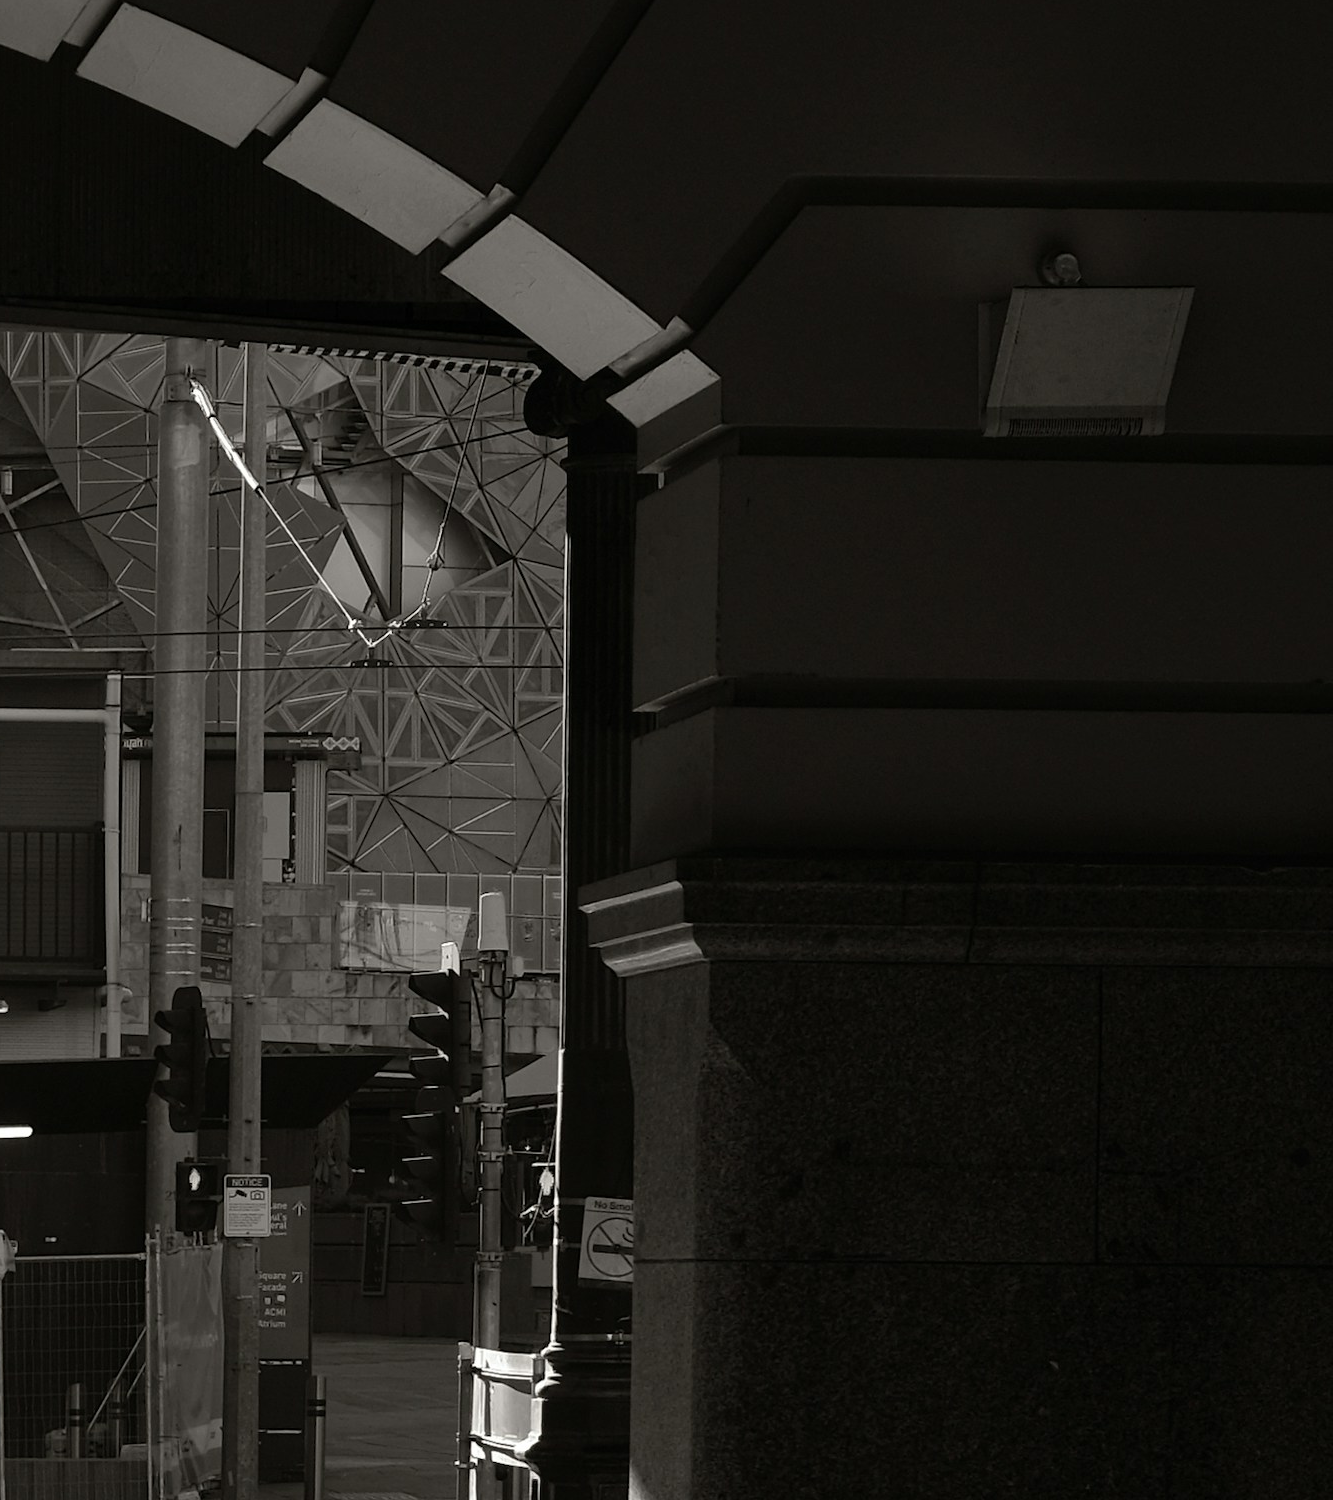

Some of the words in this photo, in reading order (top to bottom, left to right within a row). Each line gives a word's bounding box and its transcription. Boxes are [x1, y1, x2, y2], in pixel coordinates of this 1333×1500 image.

[231, 1178, 263, 1187] NOTICE
[271, 1202, 288, 1210] ane
[594, 1200, 608, 1210] No
[264, 1308, 286, 1316] ACMI
